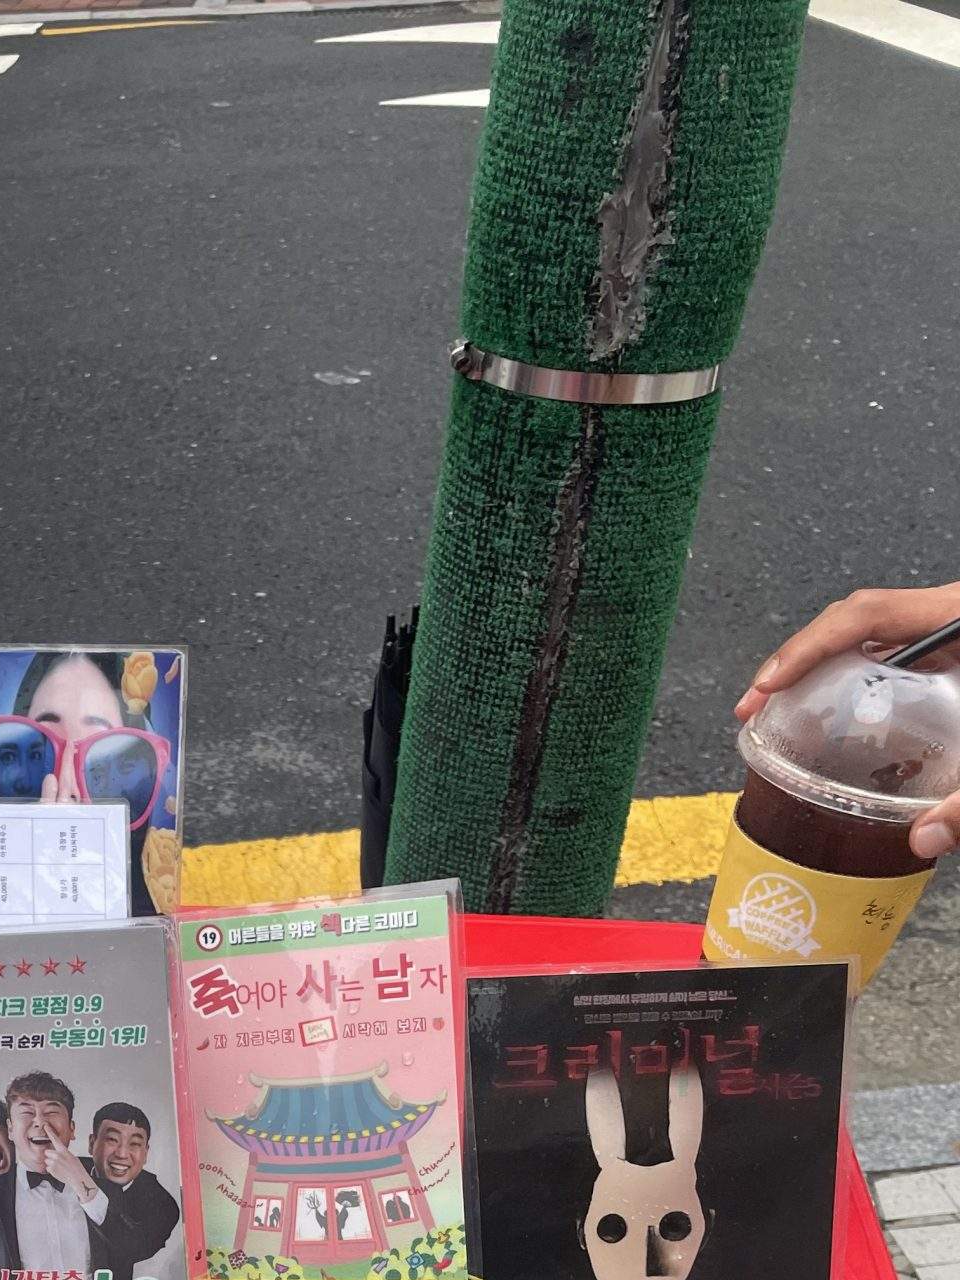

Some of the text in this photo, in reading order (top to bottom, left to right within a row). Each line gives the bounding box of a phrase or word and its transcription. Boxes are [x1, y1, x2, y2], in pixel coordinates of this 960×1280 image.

[202, 932, 217, 946] 19
[228, 924, 285, 945] 어른들을
[288, 920, 317, 939] 위한
[374, 910, 418, 931] 코미디
[190, 952, 447, 1017] 죽어야 사는 남자
[32, 996, 68, 1016] 평점
[73, 994, 103, 1014] 9.9
[17, 1034, 45, 1049] 순위
[49, 1027, 106, 1048] 부동의
[110, 1025, 146, 1046] 1위!
[214, 1033, 227, 1048] 자
[237, 1029, 295, 1047] 지금부터
[343, 1020, 387, 1038] 시작해
[397, 1017, 427, 1033] 보지
